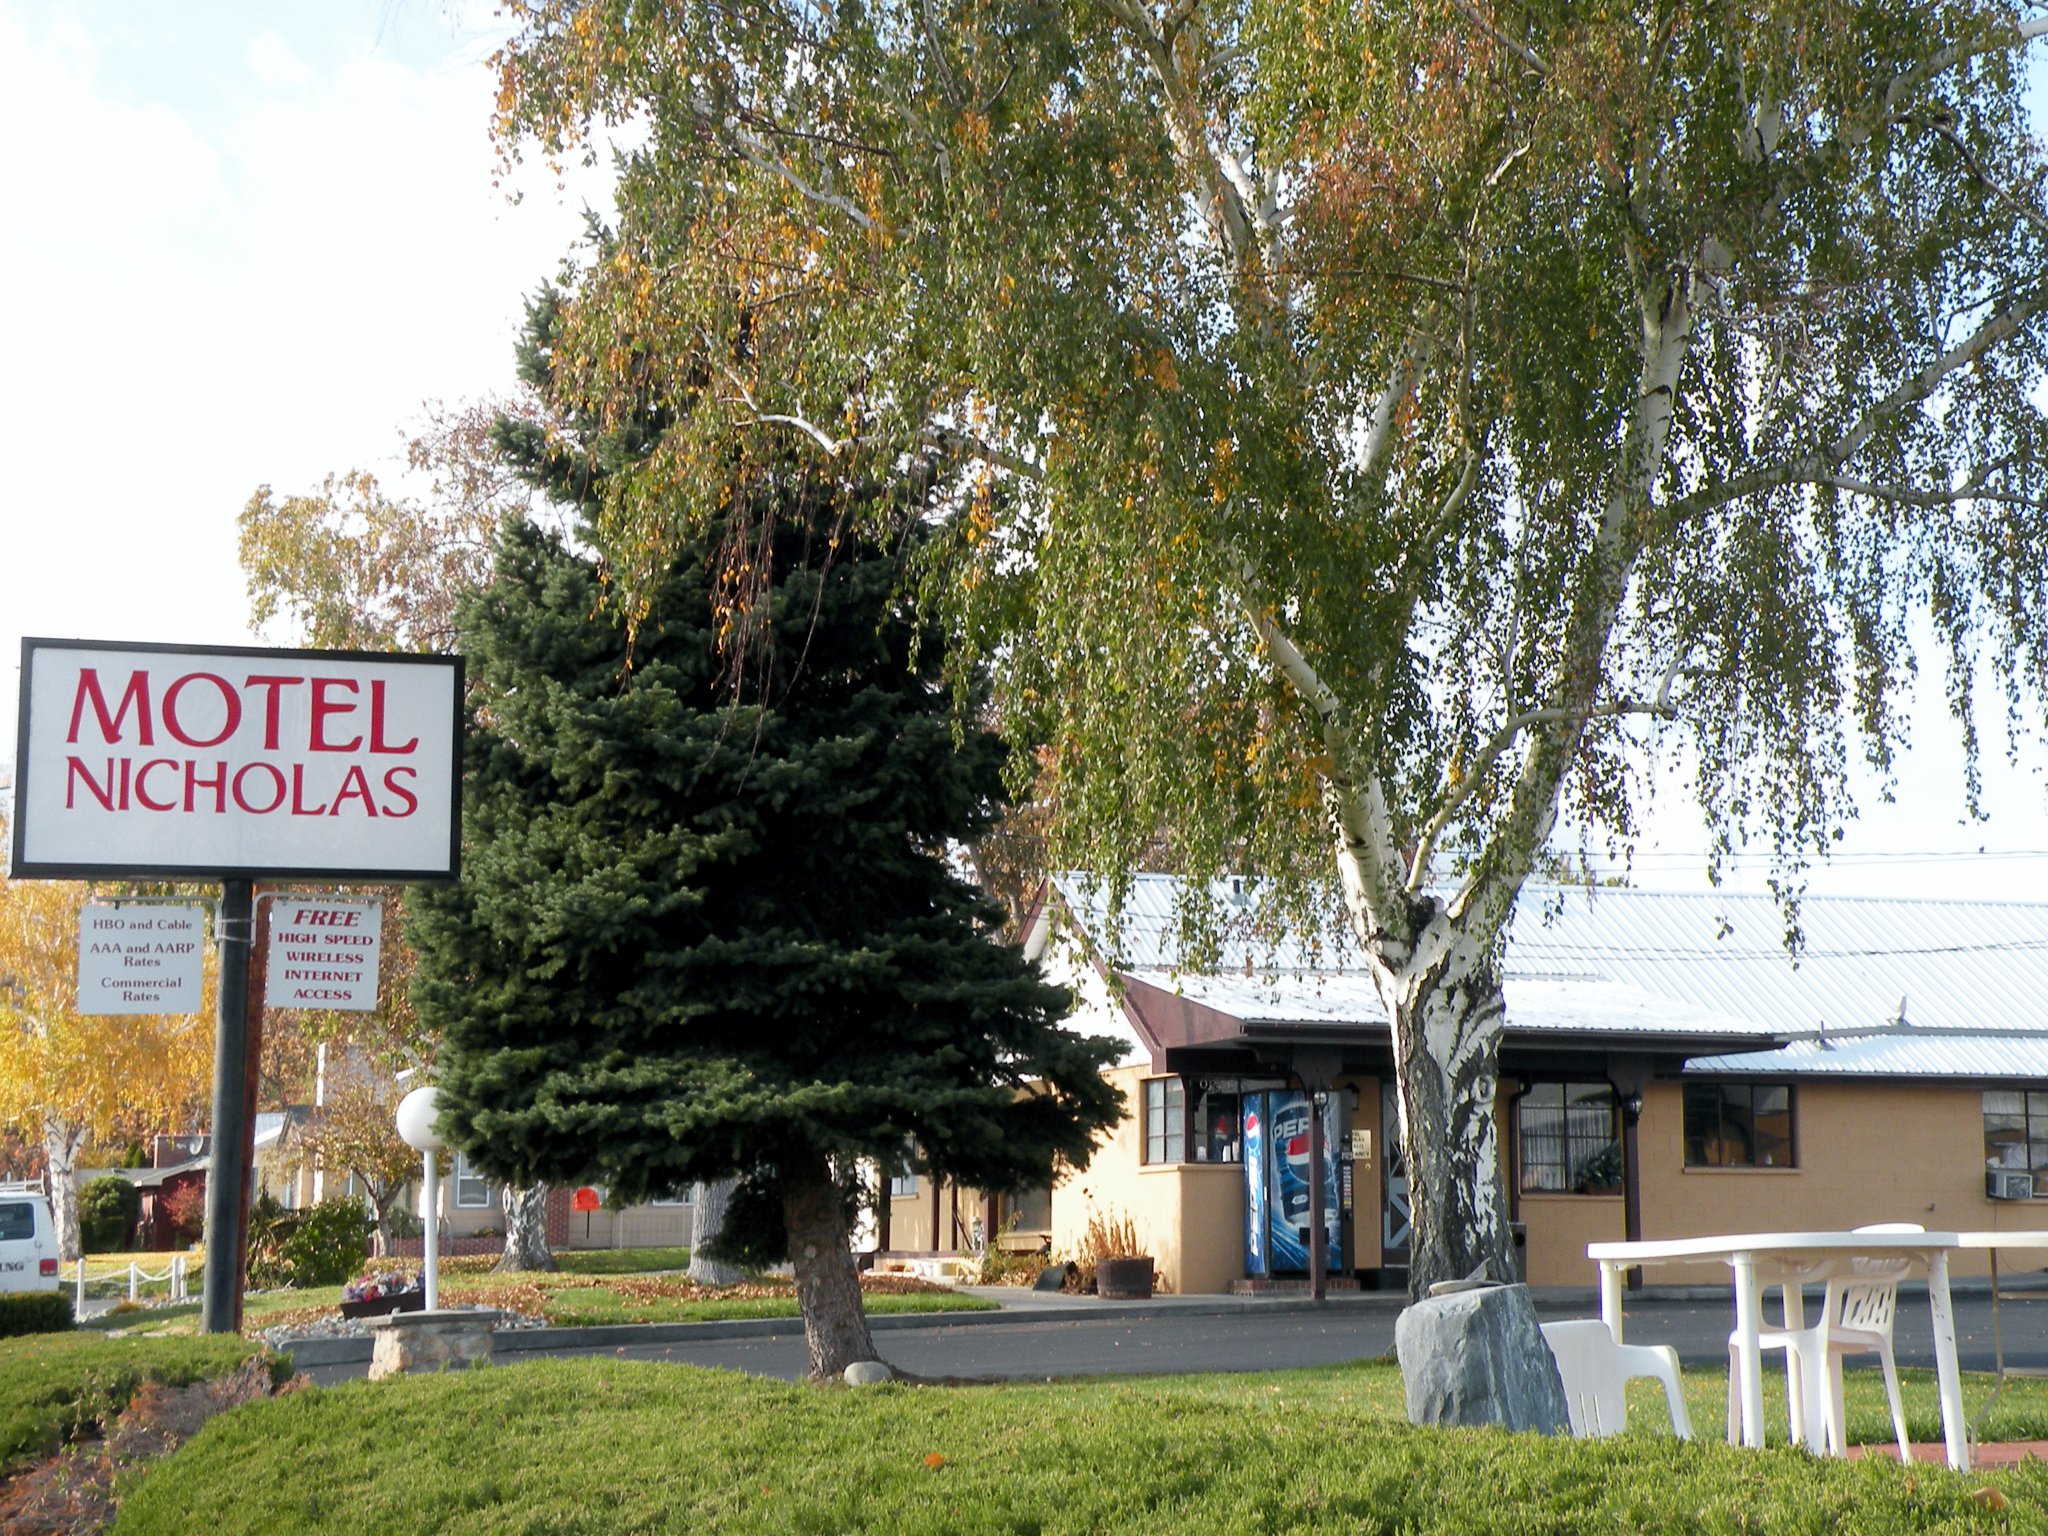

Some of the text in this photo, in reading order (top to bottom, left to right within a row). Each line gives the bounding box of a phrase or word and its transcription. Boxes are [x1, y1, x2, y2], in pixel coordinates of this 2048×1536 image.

[66, 667, 419, 754] MOTEL
[65, 756, 419, 818] NICHOLAS
[293, 909, 362, 927] FREE
[93, 919, 192, 931] HBO and Cable
[278, 932, 374, 946] HIGH SPEED
[90, 942, 195, 954] AAA and AARP
[124, 956, 161, 967] Rates
[286, 951, 364, 964] WIRELESS
[284, 969, 364, 982] INTERNET
[101, 977, 182, 988] Commercial
[123, 991, 160, 1001] Rates
[293, 988, 352, 1000] ACCESS
[1274, 1117, 1310, 1142] PEP
